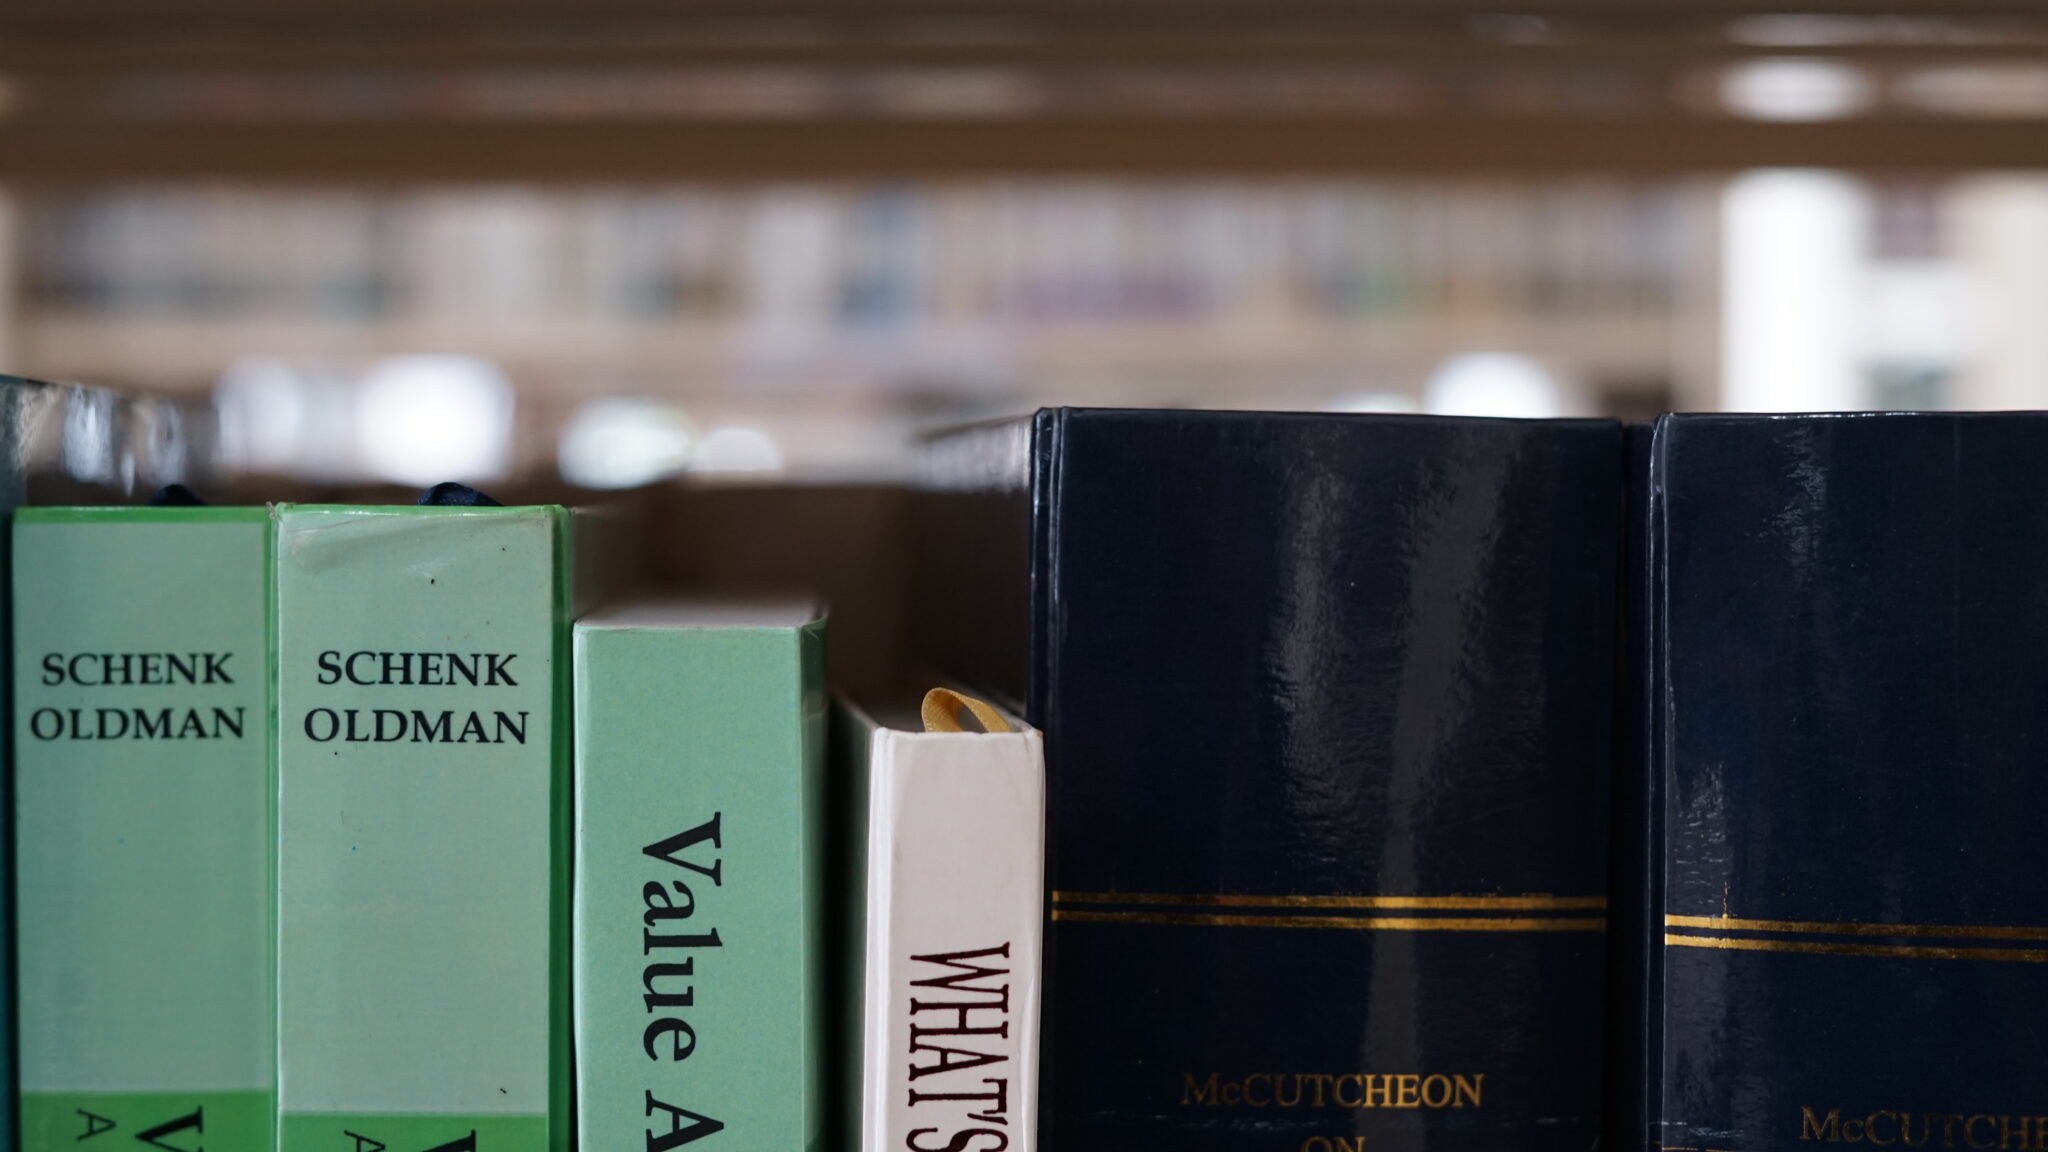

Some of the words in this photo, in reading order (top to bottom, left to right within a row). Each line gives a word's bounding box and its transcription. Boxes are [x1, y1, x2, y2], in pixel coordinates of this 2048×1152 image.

[42, 653, 234, 687] SCHENK
[318, 651, 519, 687] SCHENK
[30, 707, 245, 741] OLDMAN
[304, 708, 529, 745] OLDMAN
[643, 812, 723, 1062] Value
[906, 942, 1011, 1152] WHAT'S
[1180, 1073, 1486, 1109] McCUTCHEON
[77, 1108, 117, 1142] A
